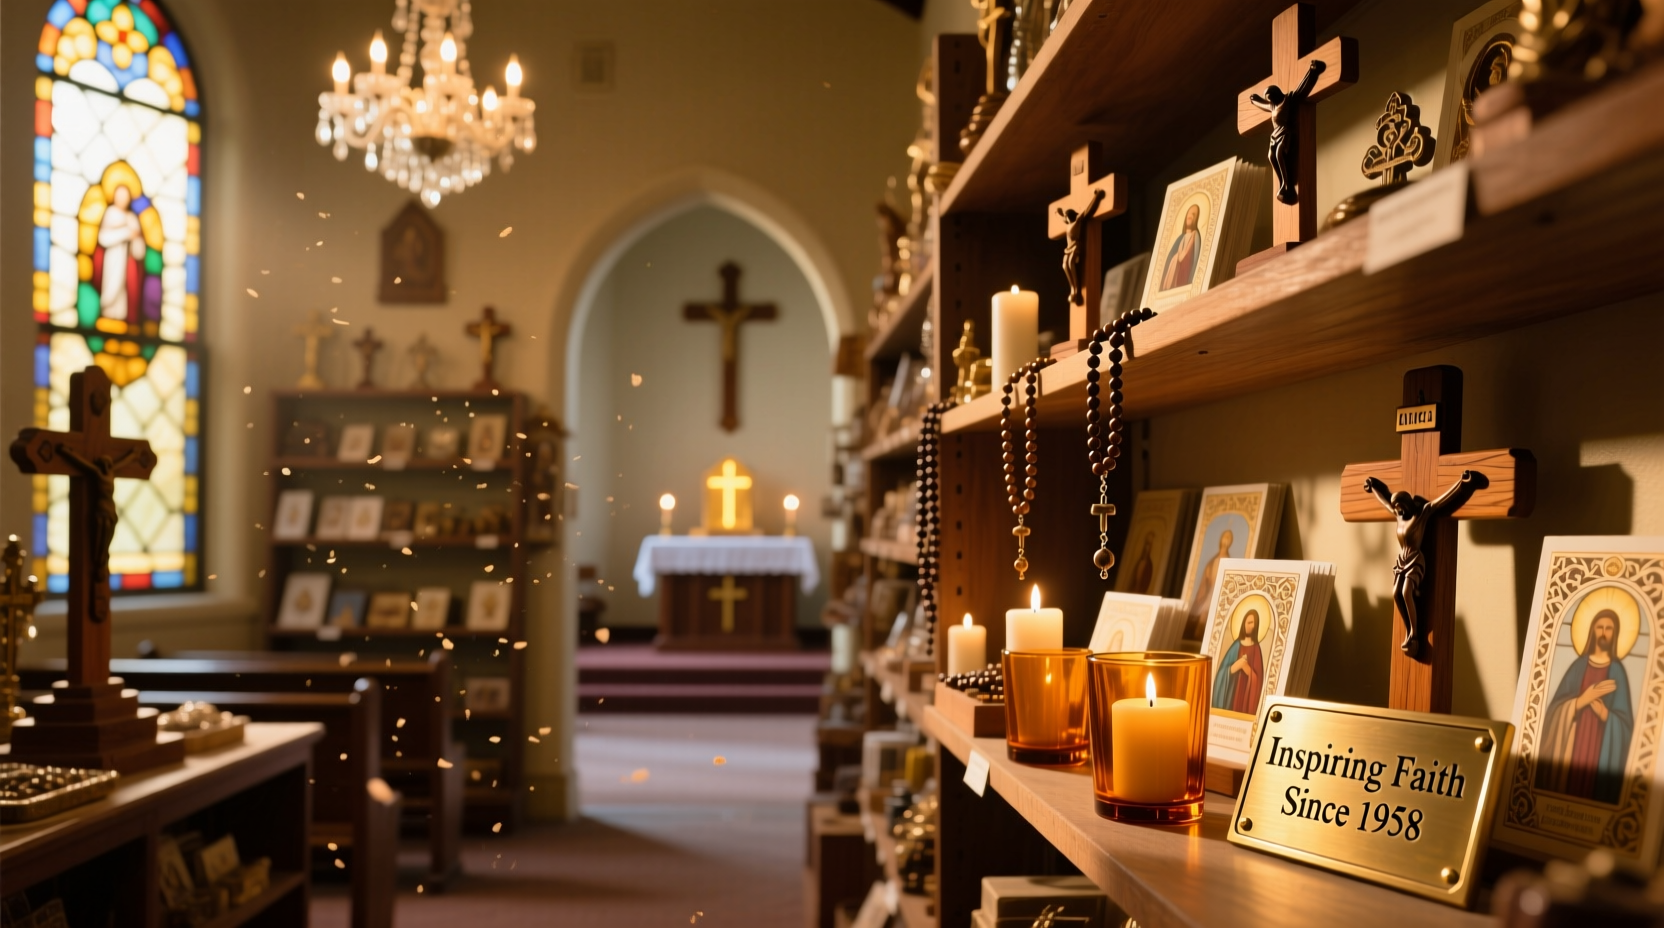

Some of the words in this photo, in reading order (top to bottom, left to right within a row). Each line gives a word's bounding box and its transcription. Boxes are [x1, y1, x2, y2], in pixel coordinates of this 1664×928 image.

[1266, 736, 1387, 793] Inspiring
[1391, 755, 1466, 798] Faith
[1281, 785, 1350, 827] Since
[1357, 801, 1424, 841] 1958
